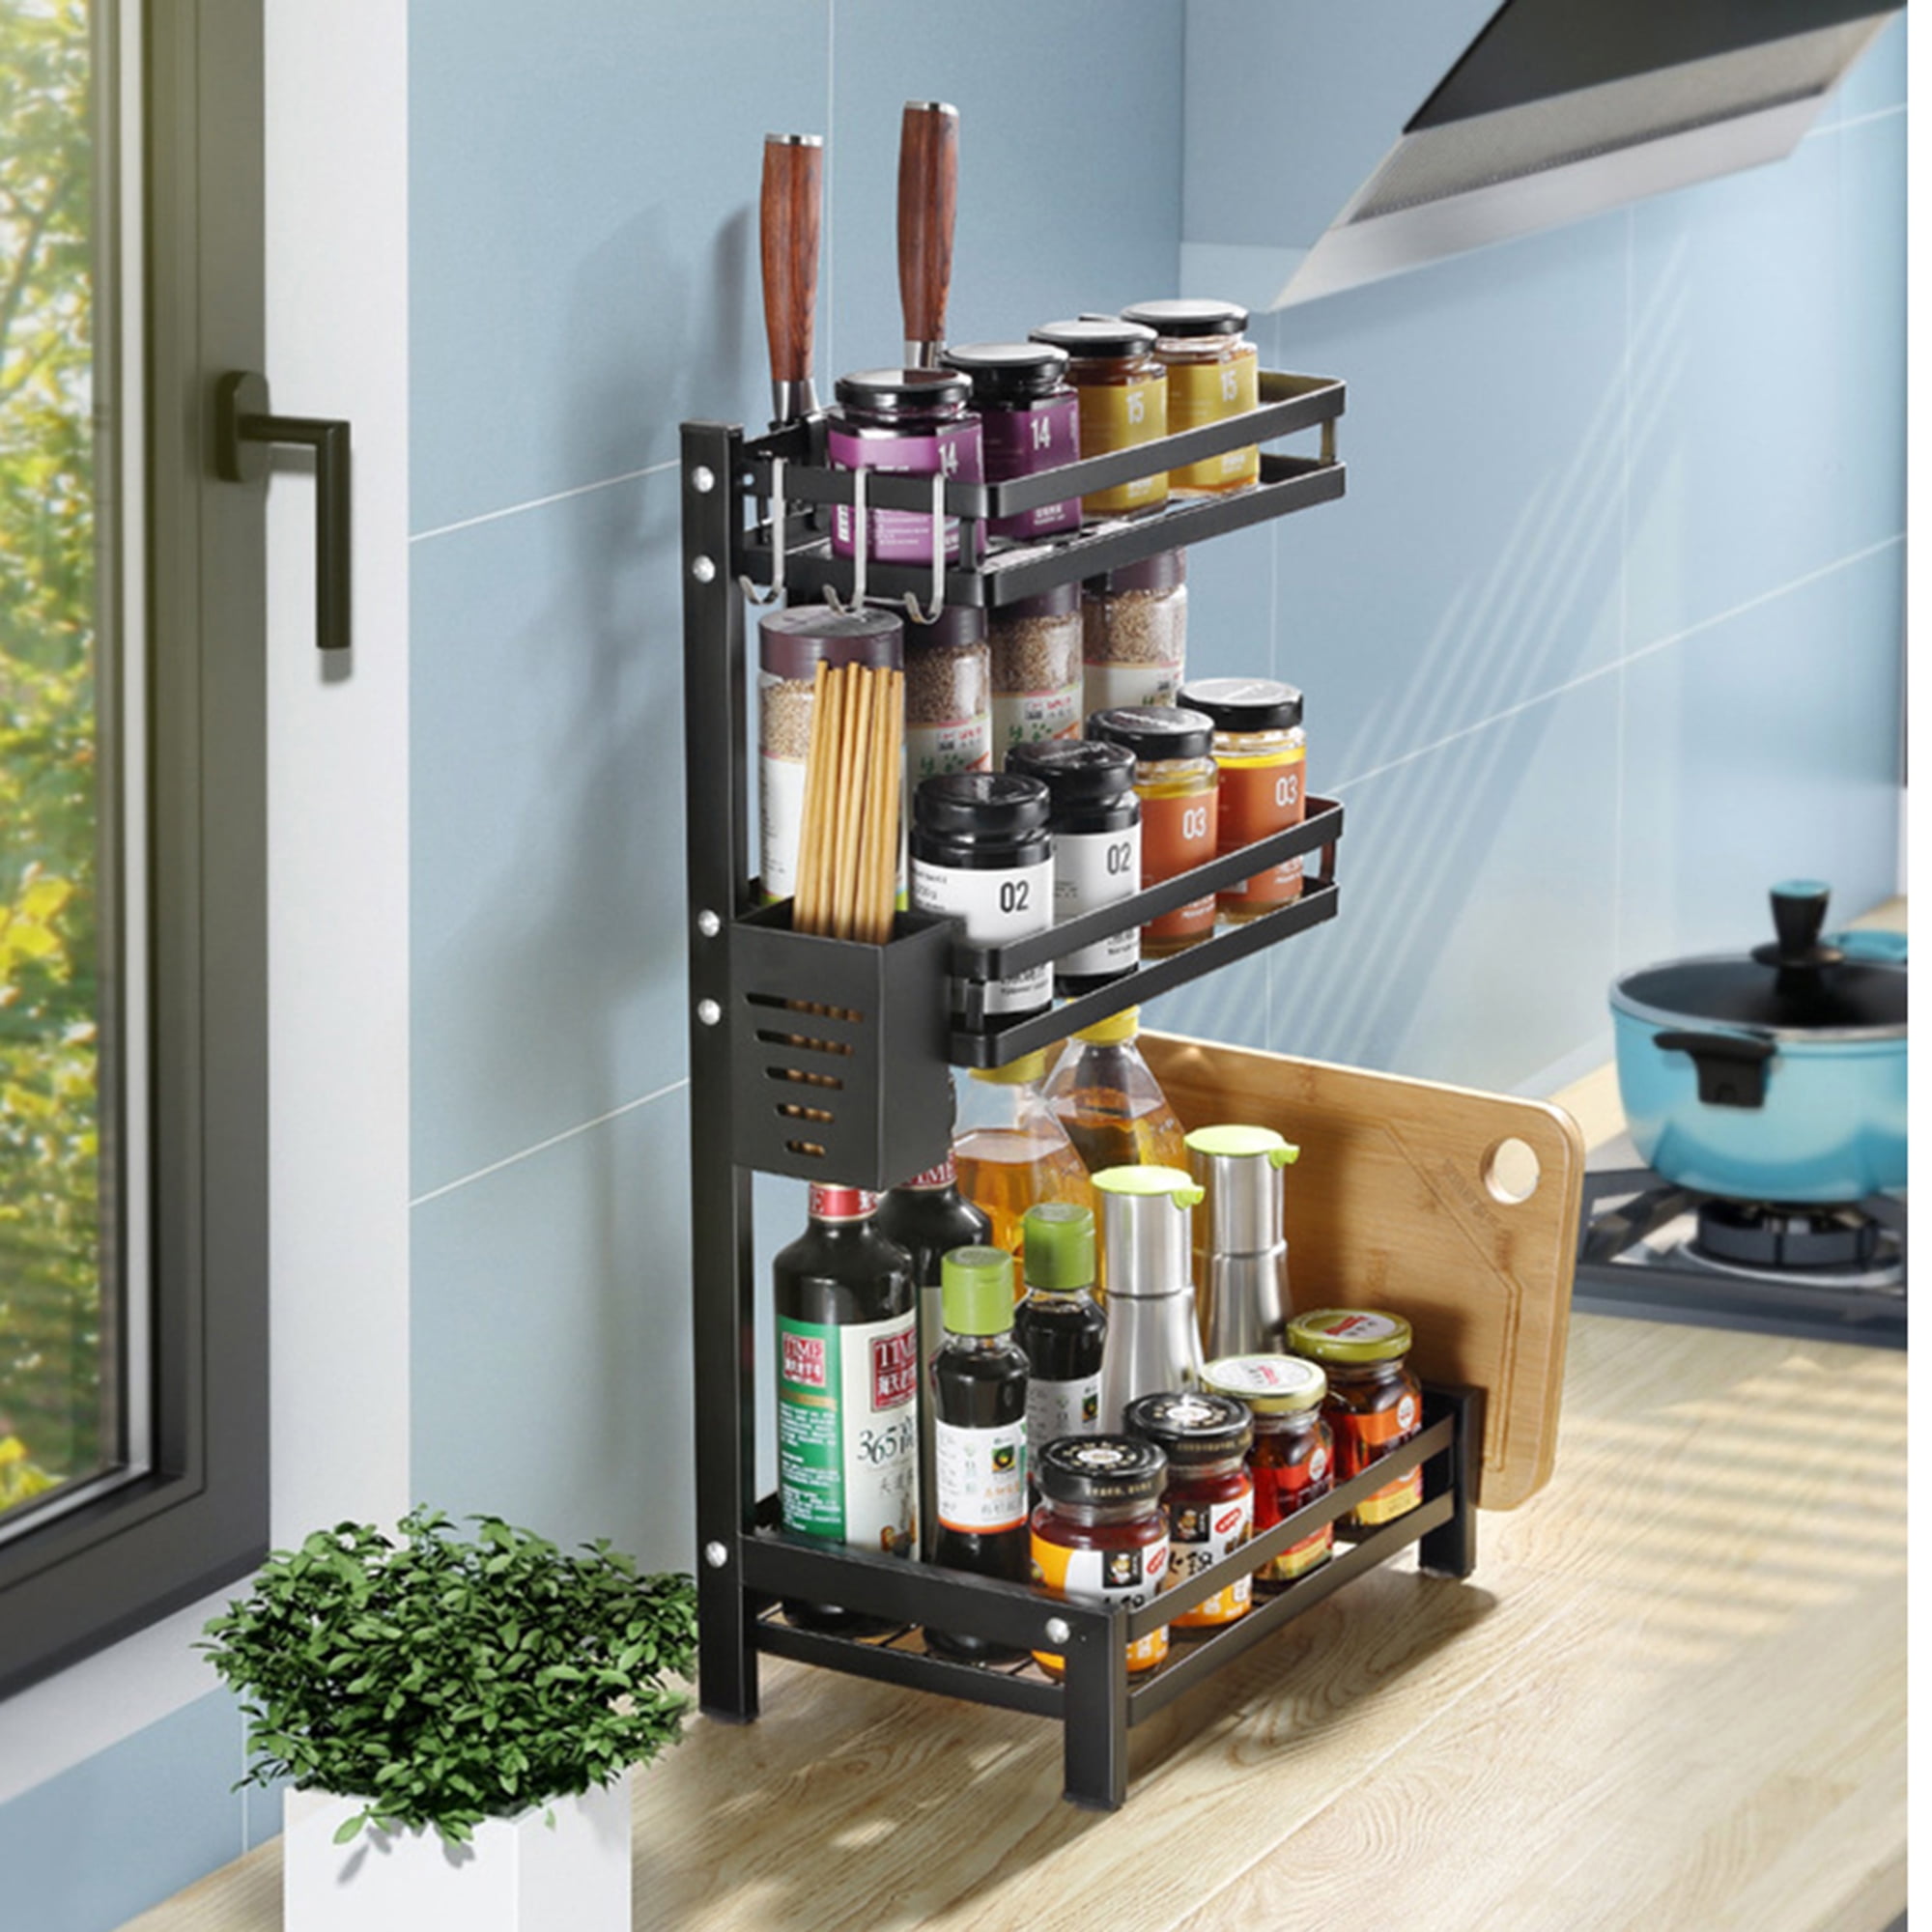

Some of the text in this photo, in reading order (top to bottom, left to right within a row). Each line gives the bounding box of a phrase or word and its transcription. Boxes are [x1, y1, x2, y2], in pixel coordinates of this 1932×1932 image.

[1221, 369, 1237, 403] 15
[1125, 391, 1145, 425] 15
[1030, 416, 1051, 450] 14
[938, 441, 958, 476] 14
[1275, 775, 1298, 808] 03
[1182, 807, 1207, 840] 03
[1106, 841, 1132, 875] 02
[999, 880, 1030, 914] 02
